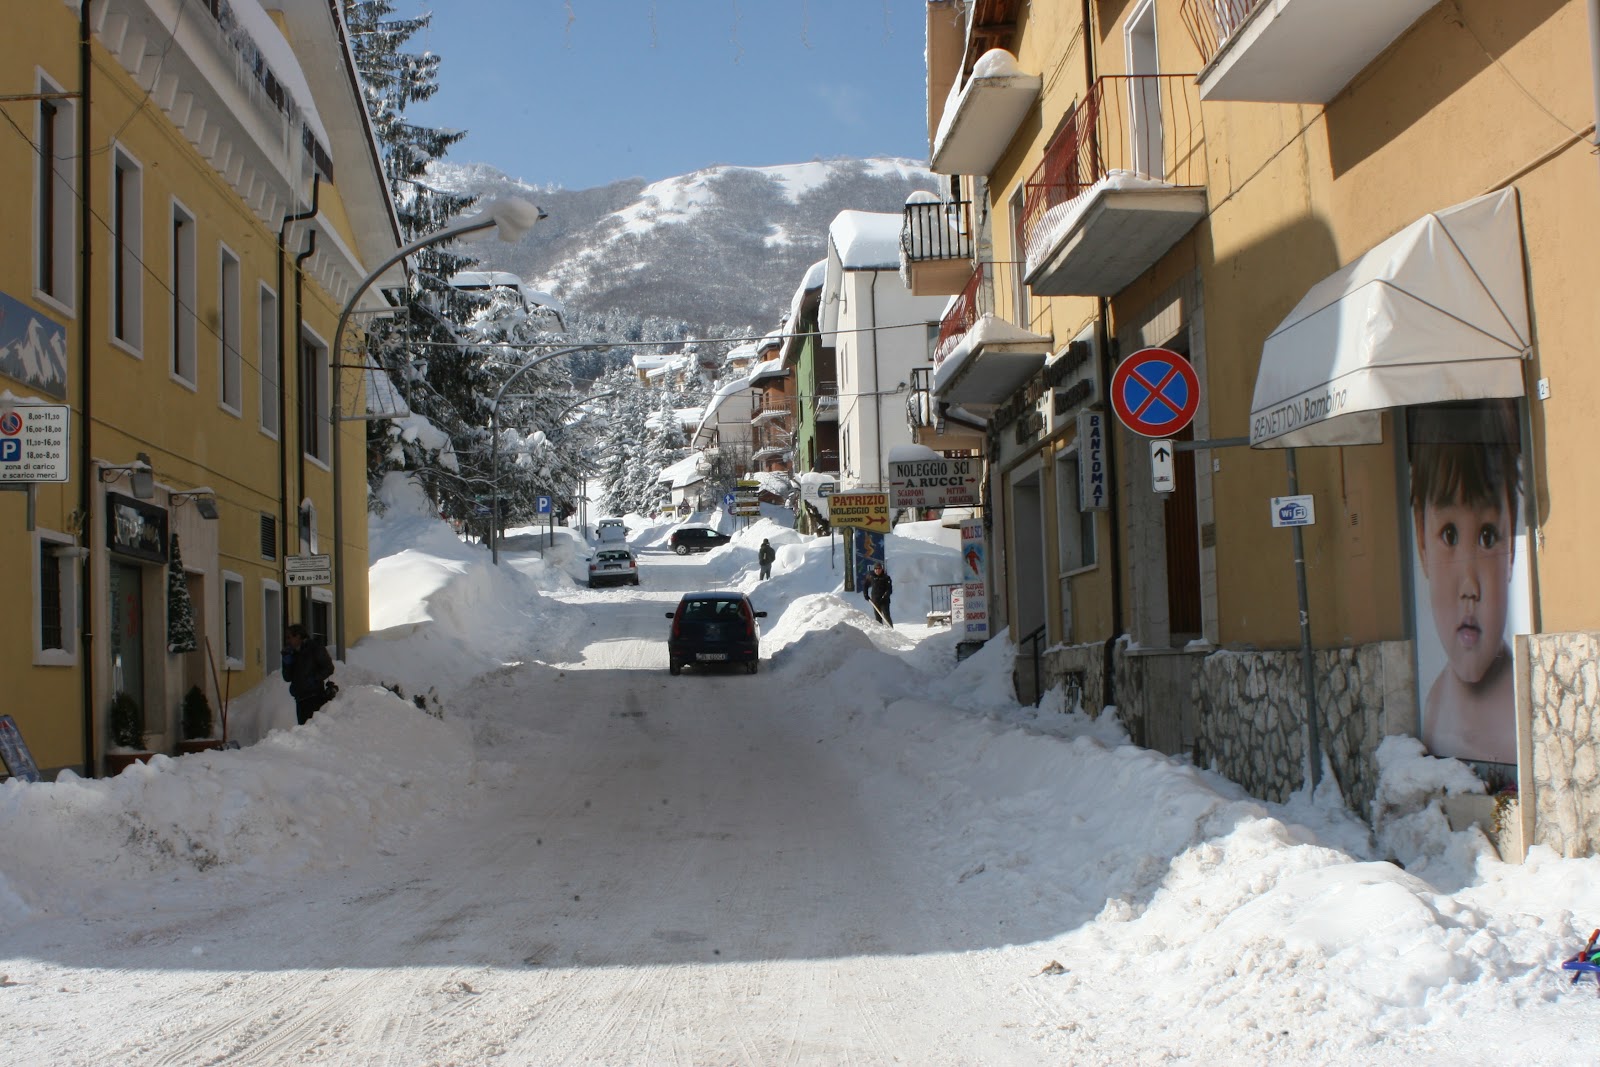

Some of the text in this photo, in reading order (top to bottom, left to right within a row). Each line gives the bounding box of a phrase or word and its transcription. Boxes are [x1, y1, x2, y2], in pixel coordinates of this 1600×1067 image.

[1254, 388, 1347, 439] BENETTON Bambino
[3, 441, 17, 459] P
[1090, 415, 1103, 507] BANCOMAT
[897, 461, 970, 477] NOLEGGIO SCI
[920, 476, 964, 487] RUCCI
[897, 487, 967, 497] SCARPONI PATTINI
[539, 498, 547, 511] P
[832, 494, 885, 507] PATRIZIO
[897, 498, 913, 506] DOPO
[916, 497, 926, 505] SCI
[830, 506, 888, 515] NOLEGGIO SCI
